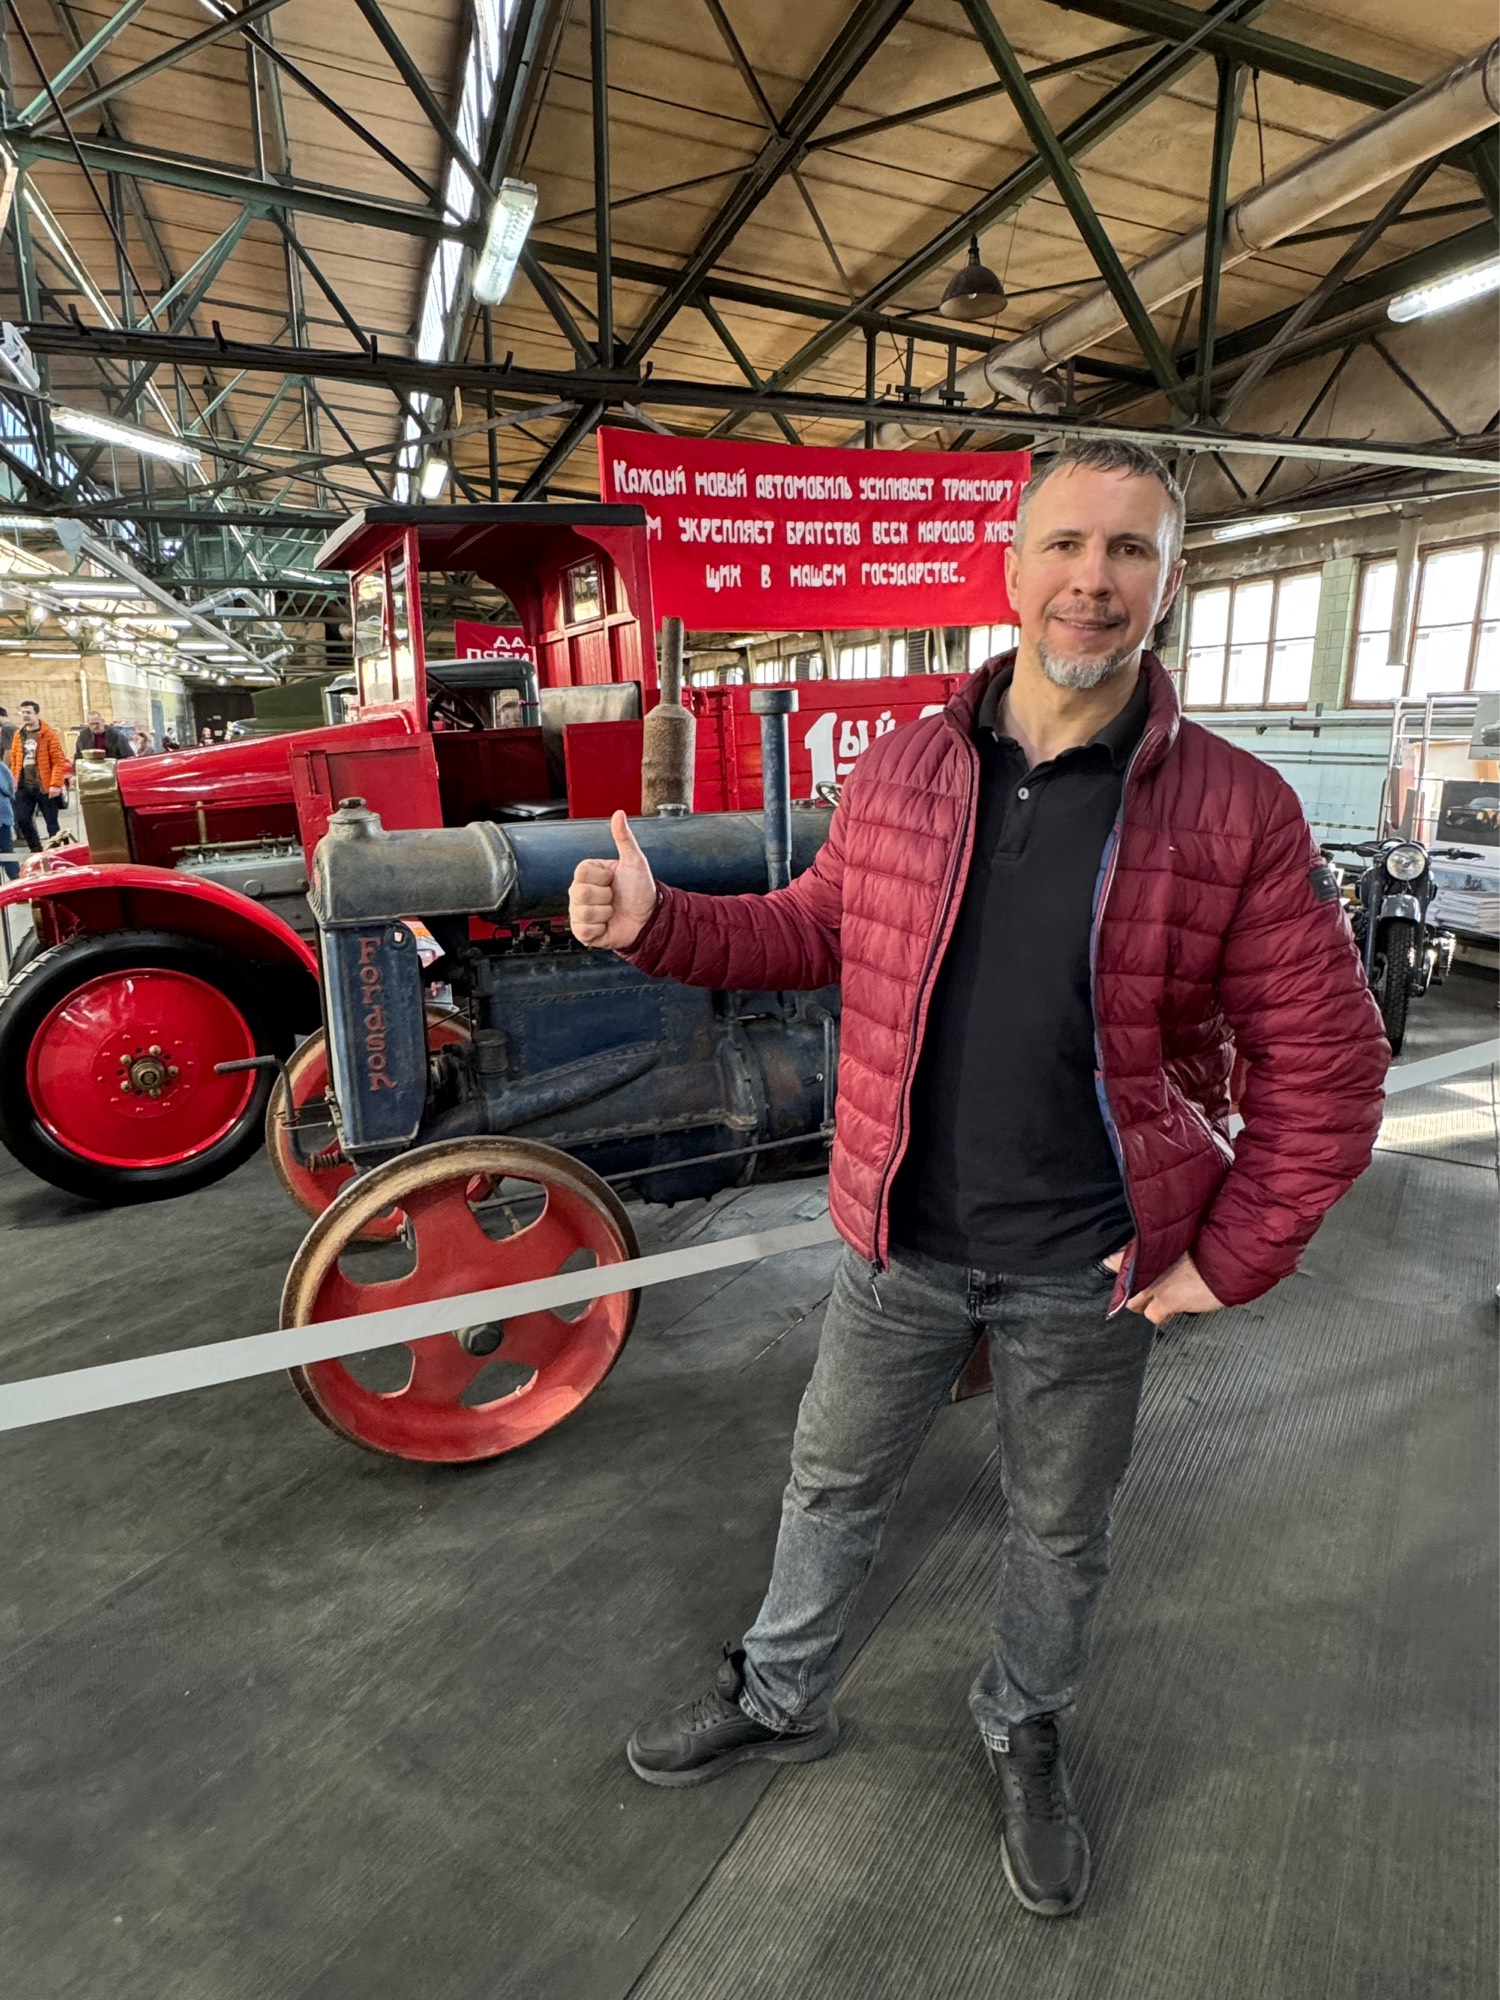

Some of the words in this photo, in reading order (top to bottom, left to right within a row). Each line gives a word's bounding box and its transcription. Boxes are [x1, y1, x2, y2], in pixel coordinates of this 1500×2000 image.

[613, 459, 687, 497] КАЖДЫЙ
[695, 468, 748, 498] НОВЫЙ
[755, 474, 853, 500] АВТОМОБИЛЬ
[859, 477, 935, 501] УСИЛИВАЕТ
[941, 478, 1014, 502] ТРАНСПОРТ
[678, 517, 775, 544] УКРЕПЛЯЕТ
[786, 521, 861, 546] БРАТСТВО
[872, 521, 908, 545] ВСЕХ
[918, 520, 975, 545] НАРОДОВ
[705, 564, 742, 593] ЩИХ
[760, 564, 772, 589] В
[789, 563, 846, 588] НАШЕМ
[861, 561, 966, 587] ГОСУДАРСТВЕ.
[358, 936, 397, 1092] Fordson
